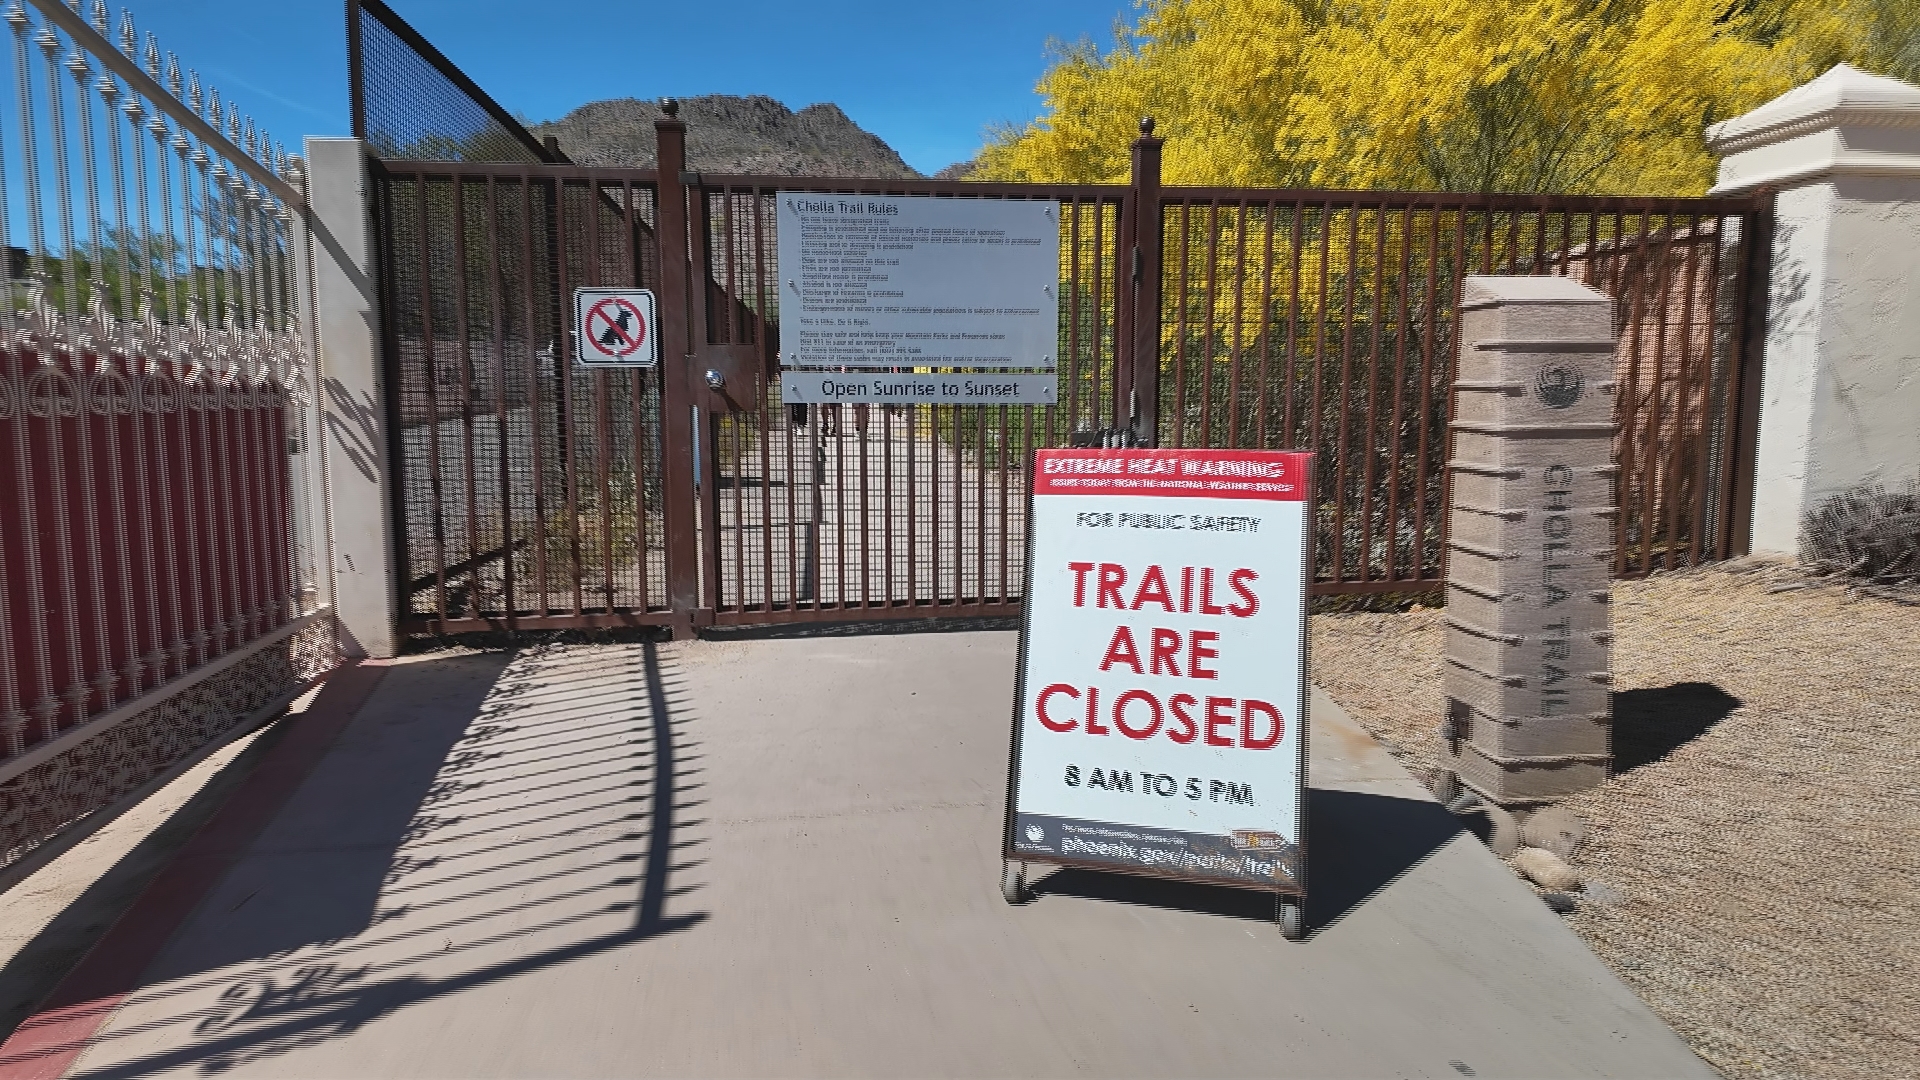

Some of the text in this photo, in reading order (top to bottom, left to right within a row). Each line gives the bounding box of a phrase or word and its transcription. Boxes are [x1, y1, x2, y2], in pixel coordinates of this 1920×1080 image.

[797, 200, 898, 215] Cholla Trail Rules
[811, 215, 820, 223] not
[822, 215, 838, 224] leave
[840, 216, 872, 226] designated
[874, 217, 889, 225] trails
[801, 223, 827, 233] Camping
[835, 224, 866, 234] prohibited
[868, 225, 878, 234] and
[916, 226, 929, 235] after
[952, 227, 968, 236] hours
[976, 228, 1005, 238] operation
[801, 231, 836, 240] Destruction
[845, 232, 869, 241] removal
[879, 233, 900, 242] natural
[901, 234, 929, 242] materials
[930, 234, 941, 243] and
[942, 235, 960, 244] plants
[1011, 236, 1041, 246] prohibited
[801, 240, 827, 249] Littering
[828, 240, 840, 248] and
[849, 241, 875, 250] dumping
[882, 241, 914, 251] prohibited
[844, 248, 866, 257] vehicles
[801, 256, 816, 265] Dogs
[829, 256, 839, 264] not
[841, 257, 864, 265] allowed
[874, 257, 885, 265] this
[887, 257, 899, 266] trail
[801, 272, 831, 282] Amplified
[832, 272, 849, 281] music
[858, 273, 888, 282] prohibited
[802, 280, 824, 288] Alcohol
[833, 280, 842, 288] not
[844, 281, 867, 289] allowed
[802, 288, 830, 297] Discharge
[841, 289, 865, 297] firearms
[873, 289, 903, 298] prohibited
[802, 296, 823, 304] Drones
[836, 297, 867, 306] prohibited
[802, 304, 845, 314] Endangerment
[855, 305, 874, 313] minors
[884, 305, 899, 313] other
[933, 306, 966, 315] populations
[974, 306, 995, 316] subject
[1004, 307, 1039, 315] enforcement
[800, 317, 813, 325] Take
[800, 330, 819, 338] Please
[821, 330, 833, 339] stay
[835, 330, 846, 338] safe
[861, 331, 874, 340] help
[876, 331, 889, 340] keep
[891, 332, 903, 340] your
[906, 331, 931, 339] Mountain
[990, 332, 1004, 340] clean
[800, 338, 812, 346] Dial
[813, 338, 823, 346] 911
[864, 340, 896, 348] emergency
[800, 346, 810, 354] For
[837, 354, 853, 362] these
[886, 354, 902, 362] result
[822, 380, 1020, 399] Open Sunrise to Sunset
[1044, 459, 1284, 478] EXTREME HEAT WARNING
[1050, 478, 1294, 492] ISSUED TODAY FROM THE NATIONAL WEATHER SERVICE
[1076, 513, 1261, 532] FOR PUBLIC SAFETY
[1068, 562, 1261, 618] TRAILS
[1541, 464, 1572, 717] CHOLLA TRAIL
[1098, 626, 1220, 680] ARE
[1034, 683, 1286, 750] CLOSED
[1064, 764, 1254, 806] 8 AM TO 5 PM
[1062, 823, 1076, 831] For
[1075, 825, 1096, 833] more
[1141, 832, 1170, 843] please
[1169, 836, 1187, 845] visit
